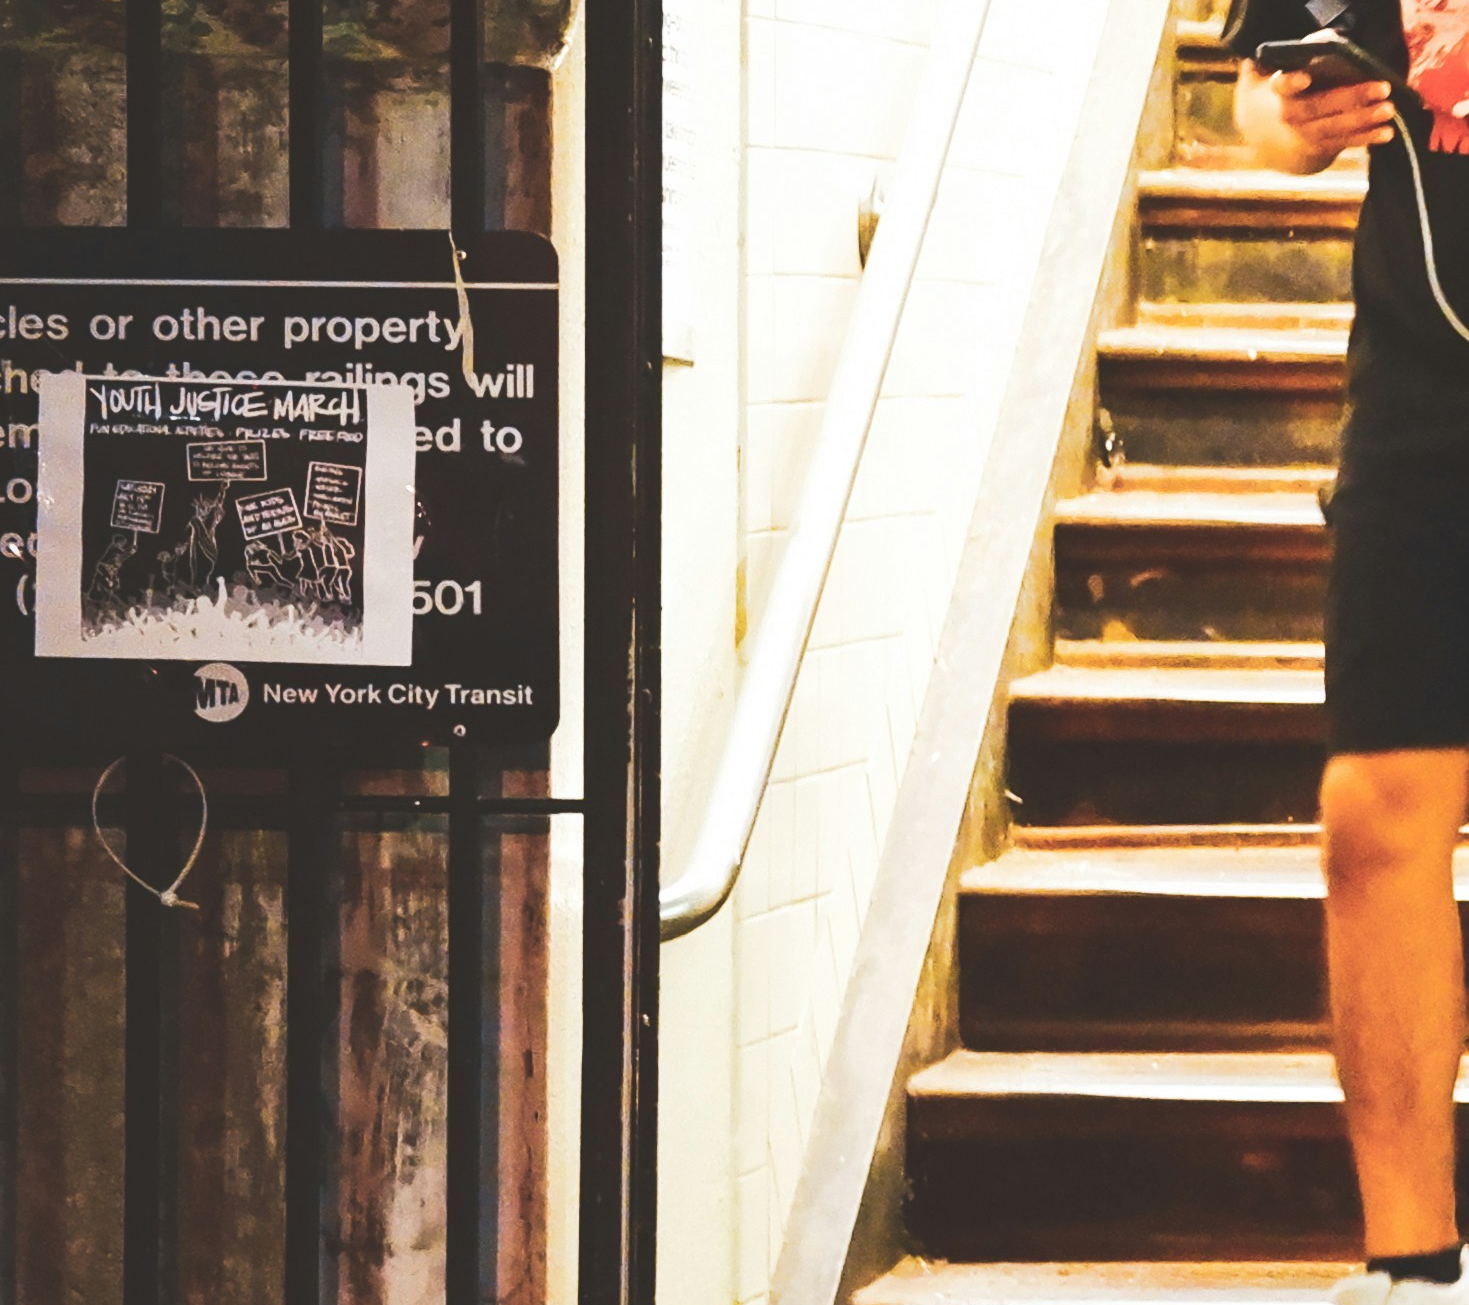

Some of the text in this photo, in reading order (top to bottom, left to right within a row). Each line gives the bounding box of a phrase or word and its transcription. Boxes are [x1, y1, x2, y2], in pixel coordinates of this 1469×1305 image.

[0, 305, 462, 351] les or other property
[473, 363, 534, 399] will
[90, 382, 361, 426] YOUTH JUSTICE MARCH
[480, 419, 523, 454] to
[413, 579, 482, 616] 501
[263, 683, 534, 710] New York City Transit
